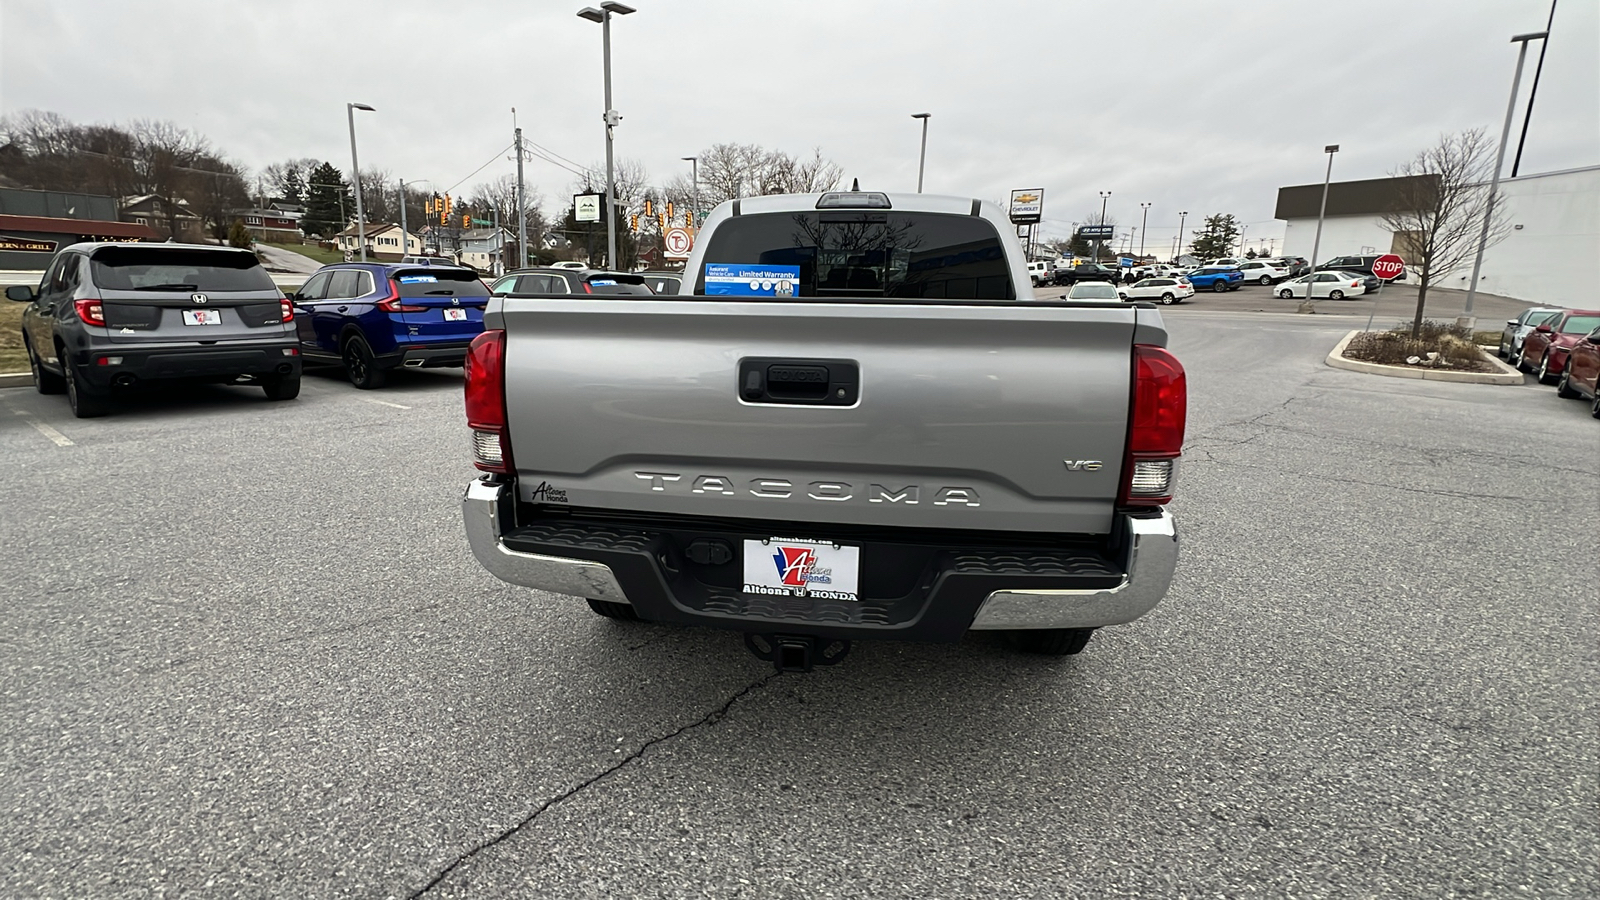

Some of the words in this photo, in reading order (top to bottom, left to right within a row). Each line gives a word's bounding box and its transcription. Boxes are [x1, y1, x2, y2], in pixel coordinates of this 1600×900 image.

[1374, 261, 1403, 273] STOP
[772, 370, 824, 381] TOYOTA
[1063, 460, 1103, 471] V6
[634, 471, 981, 507] TACOMA
[547, 495, 569, 503] Honda
[769, 536, 833, 545] altoonahonda.com
[801, 573, 832, 584] Honda
[742, 584, 790, 596] Altoona
[810, 590, 859, 602] HONDA
